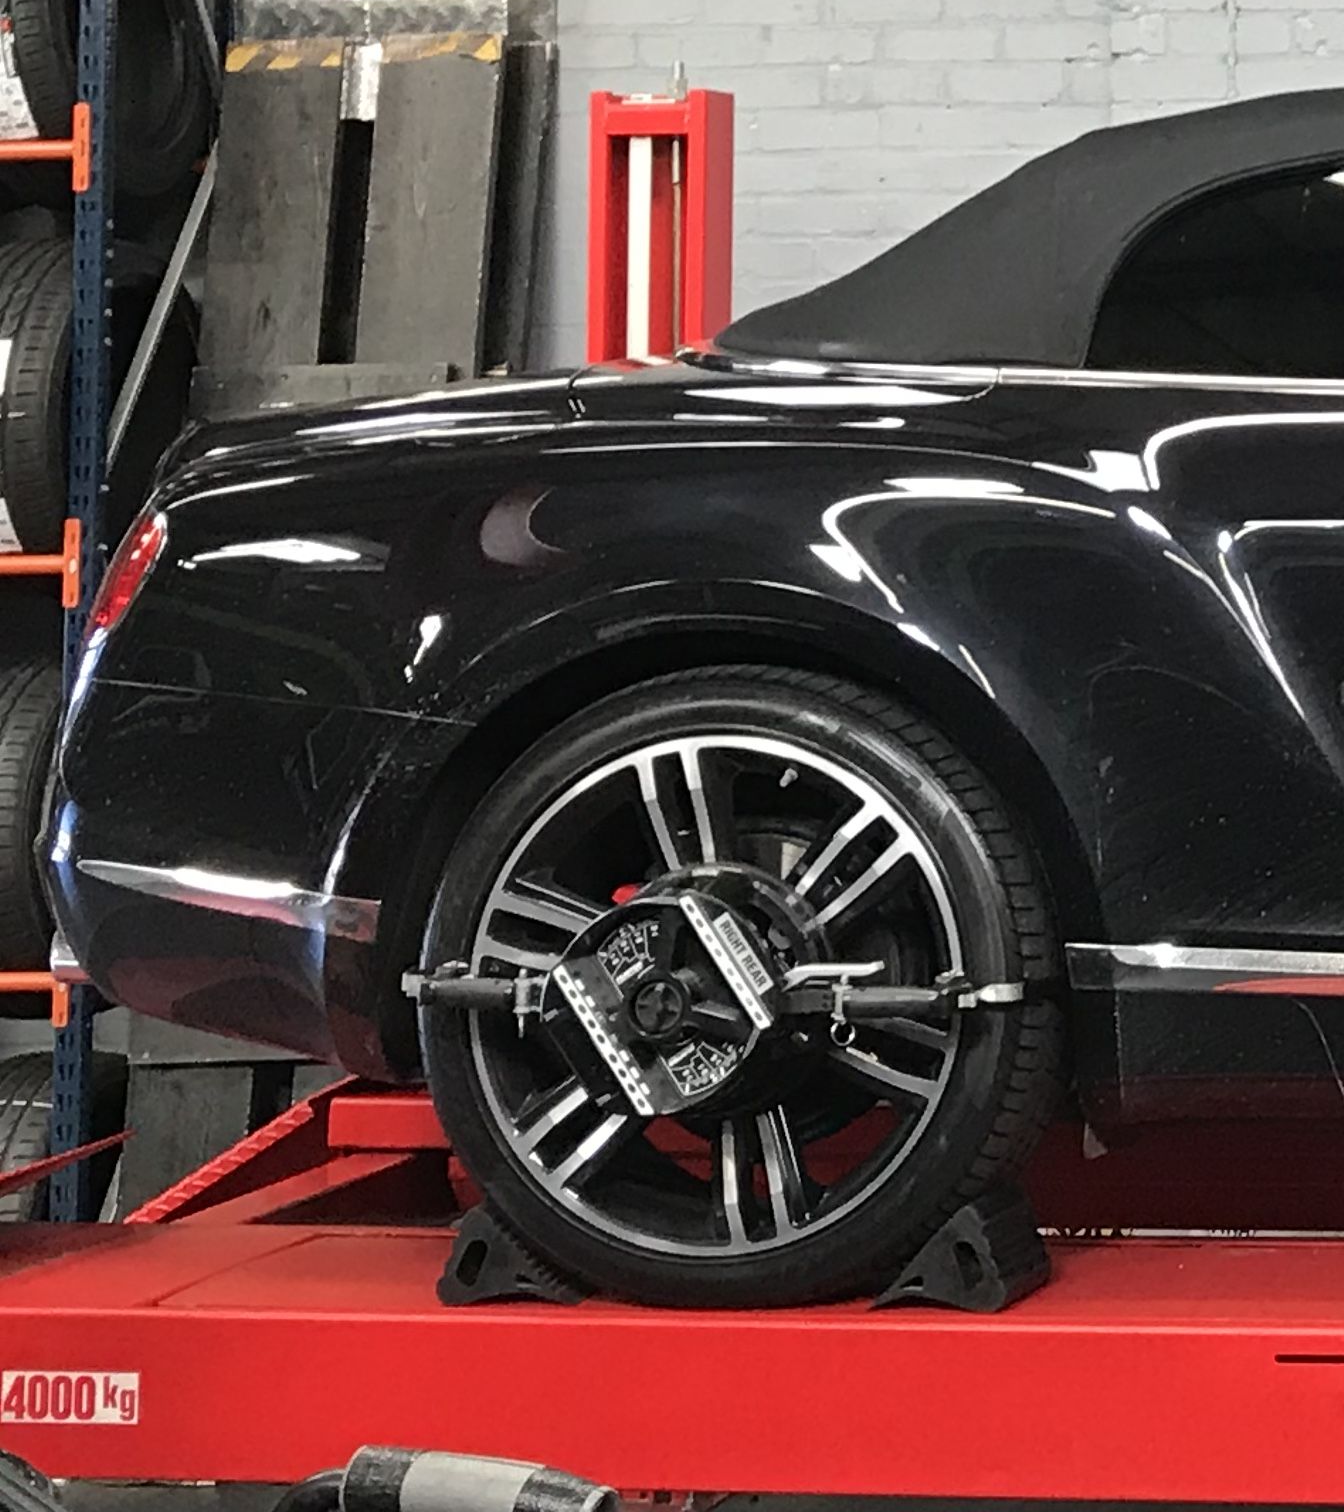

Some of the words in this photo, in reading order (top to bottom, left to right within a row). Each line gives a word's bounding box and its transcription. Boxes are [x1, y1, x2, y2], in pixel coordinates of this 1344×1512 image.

[720, 919, 748, 955] RIGHT
[741, 954, 767, 987] REAR
[4, 1375, 96, 1420] 4000
[103, 1376, 136, 1421] kg
